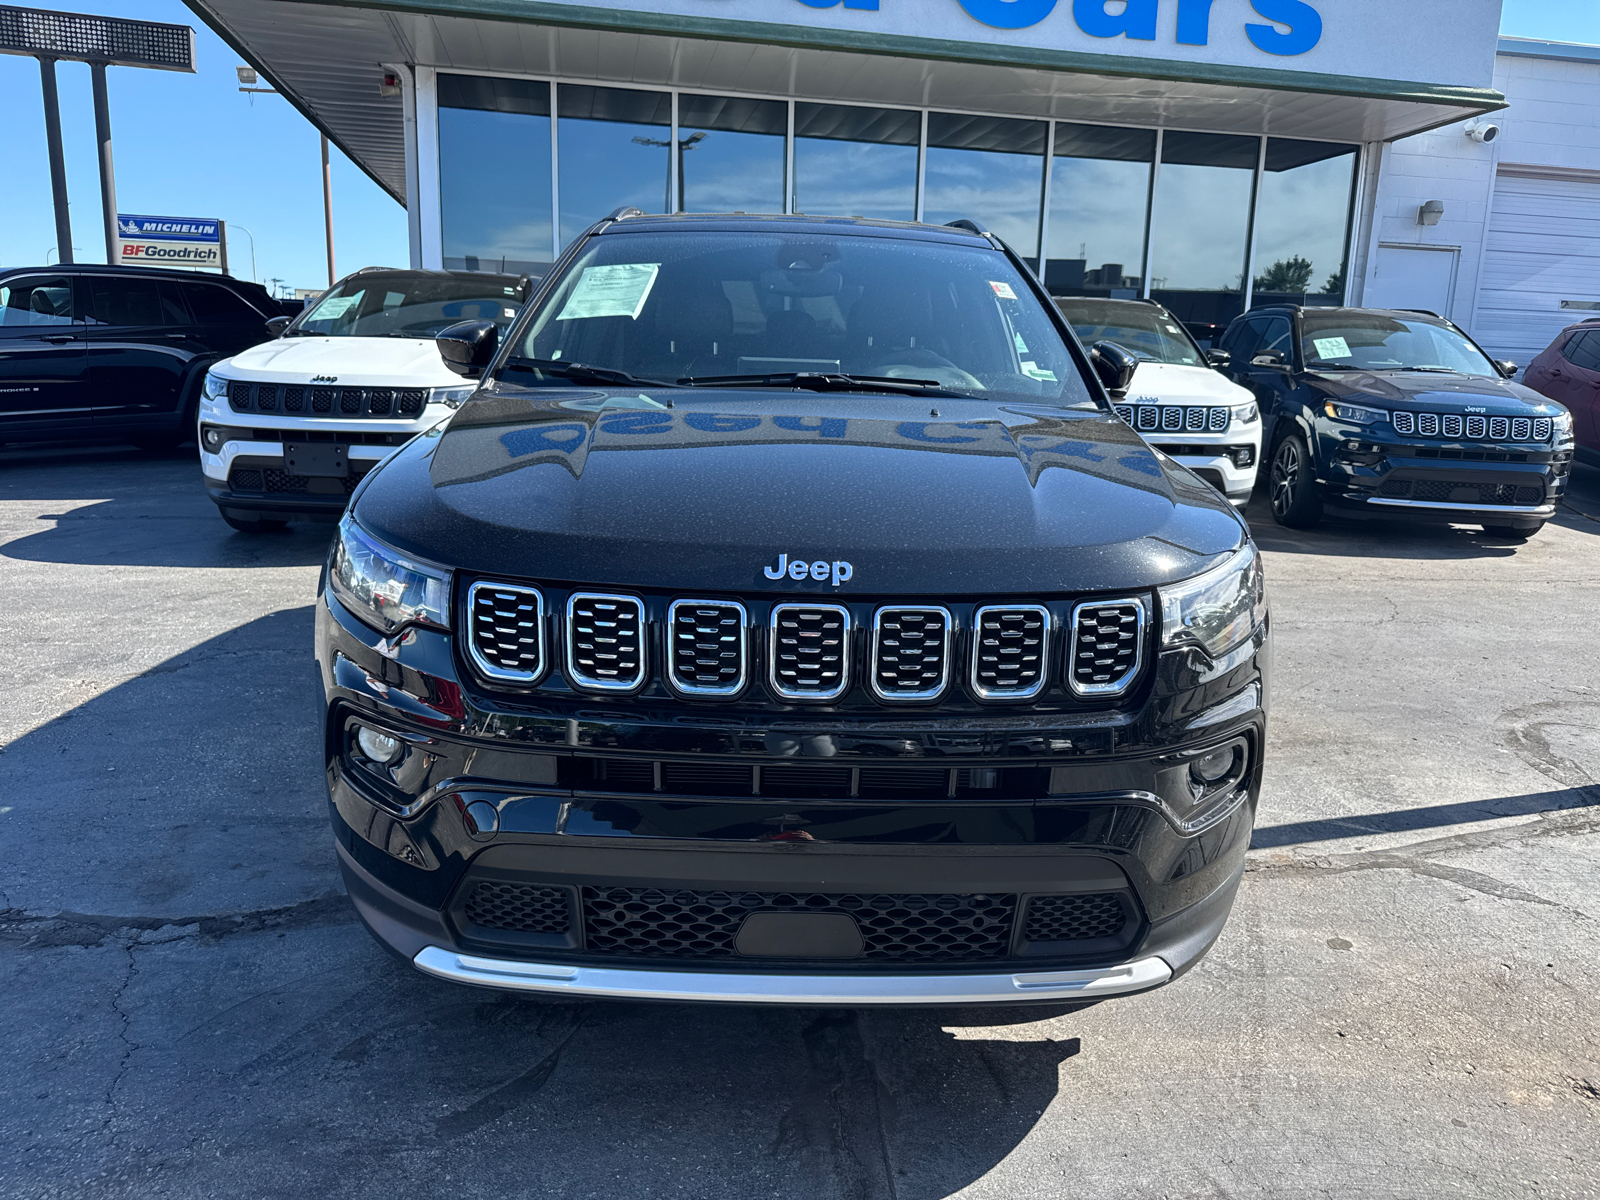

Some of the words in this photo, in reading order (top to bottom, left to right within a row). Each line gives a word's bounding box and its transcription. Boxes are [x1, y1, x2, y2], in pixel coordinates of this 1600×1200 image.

[957, 0, 1323, 57] ars
[142, 222, 215, 234] MICHELIN
[122, 244, 217, 260] BFGoodrich
[312, 374, 338, 384] Jeep
[1464, 405, 1486, 414] Jeep
[763, 553, 853, 587] Jeep
